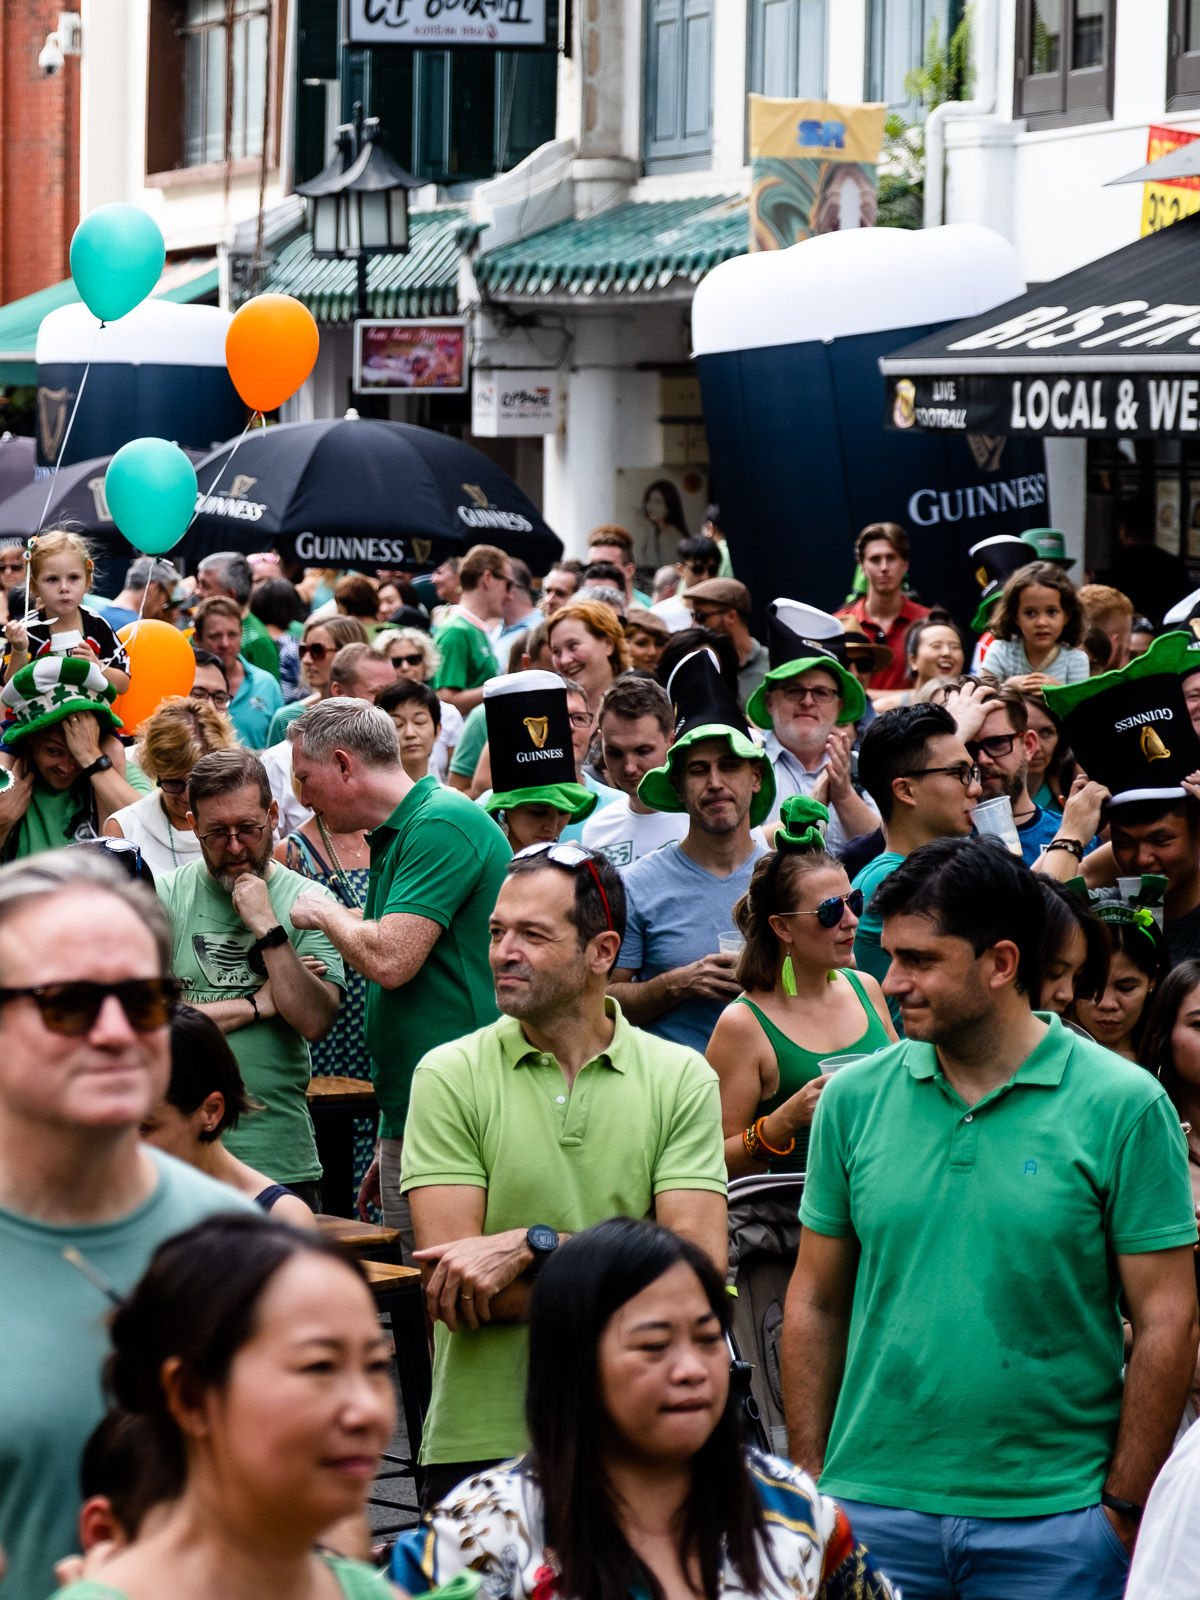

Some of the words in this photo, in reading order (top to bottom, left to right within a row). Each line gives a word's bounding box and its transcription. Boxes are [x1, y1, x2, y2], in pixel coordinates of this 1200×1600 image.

[932, 381, 957, 401] LIVE
[915, 407, 967, 429] FOOTBALL
[1011, 379, 1107, 430] LOCAL
[1115, 379, 1139, 430] &
[1148, 379, 1200, 431] WE
[907, 472, 1048, 526] GUINNESS
[457, 505, 533, 532] GUINNESS
[295, 532, 404, 563] GUINNESS
[1114, 708, 1173, 733] GUINNESS
[516, 748, 564, 763] GUINNESS
